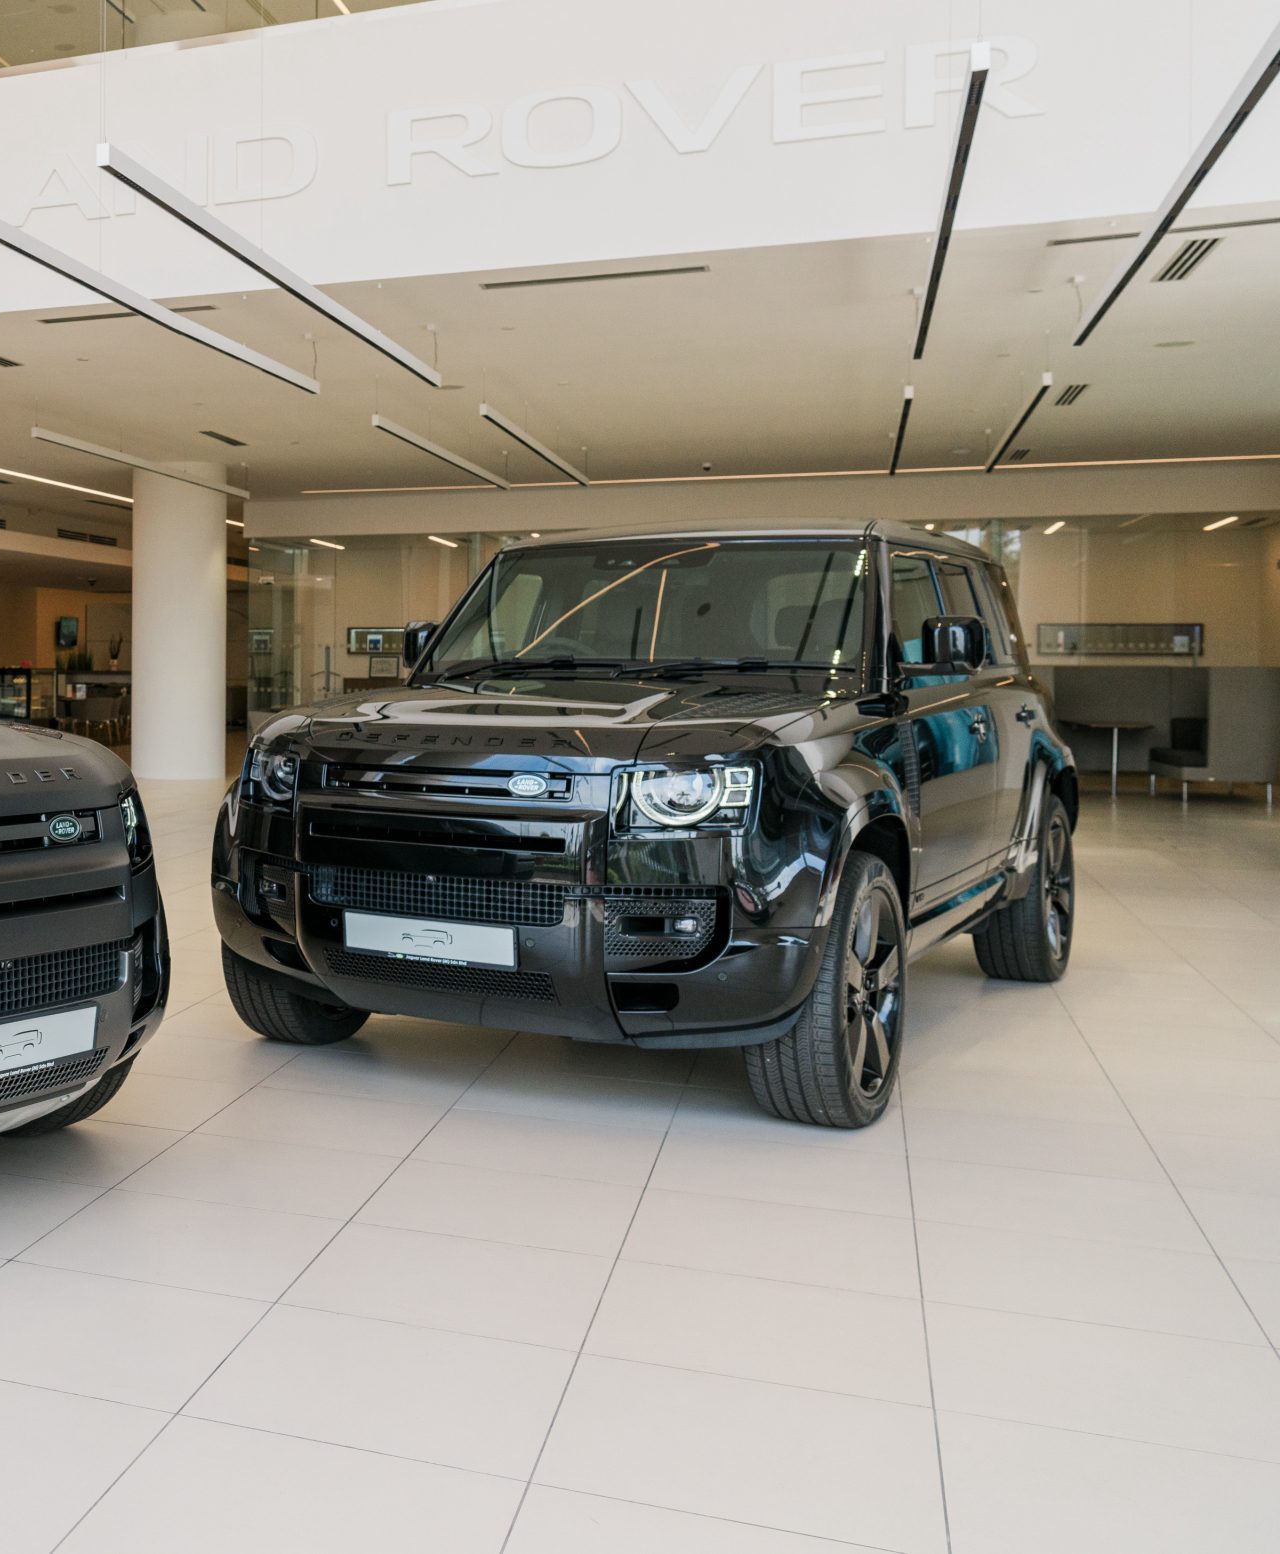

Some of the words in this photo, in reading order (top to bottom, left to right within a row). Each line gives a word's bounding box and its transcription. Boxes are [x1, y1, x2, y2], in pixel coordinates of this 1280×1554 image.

[386, 34, 1047, 186] ROVER
[336, 731, 573, 750] DEFENDER
[55, 821, 70, 829] LAND
[58, 827, 75, 835] ROVER
